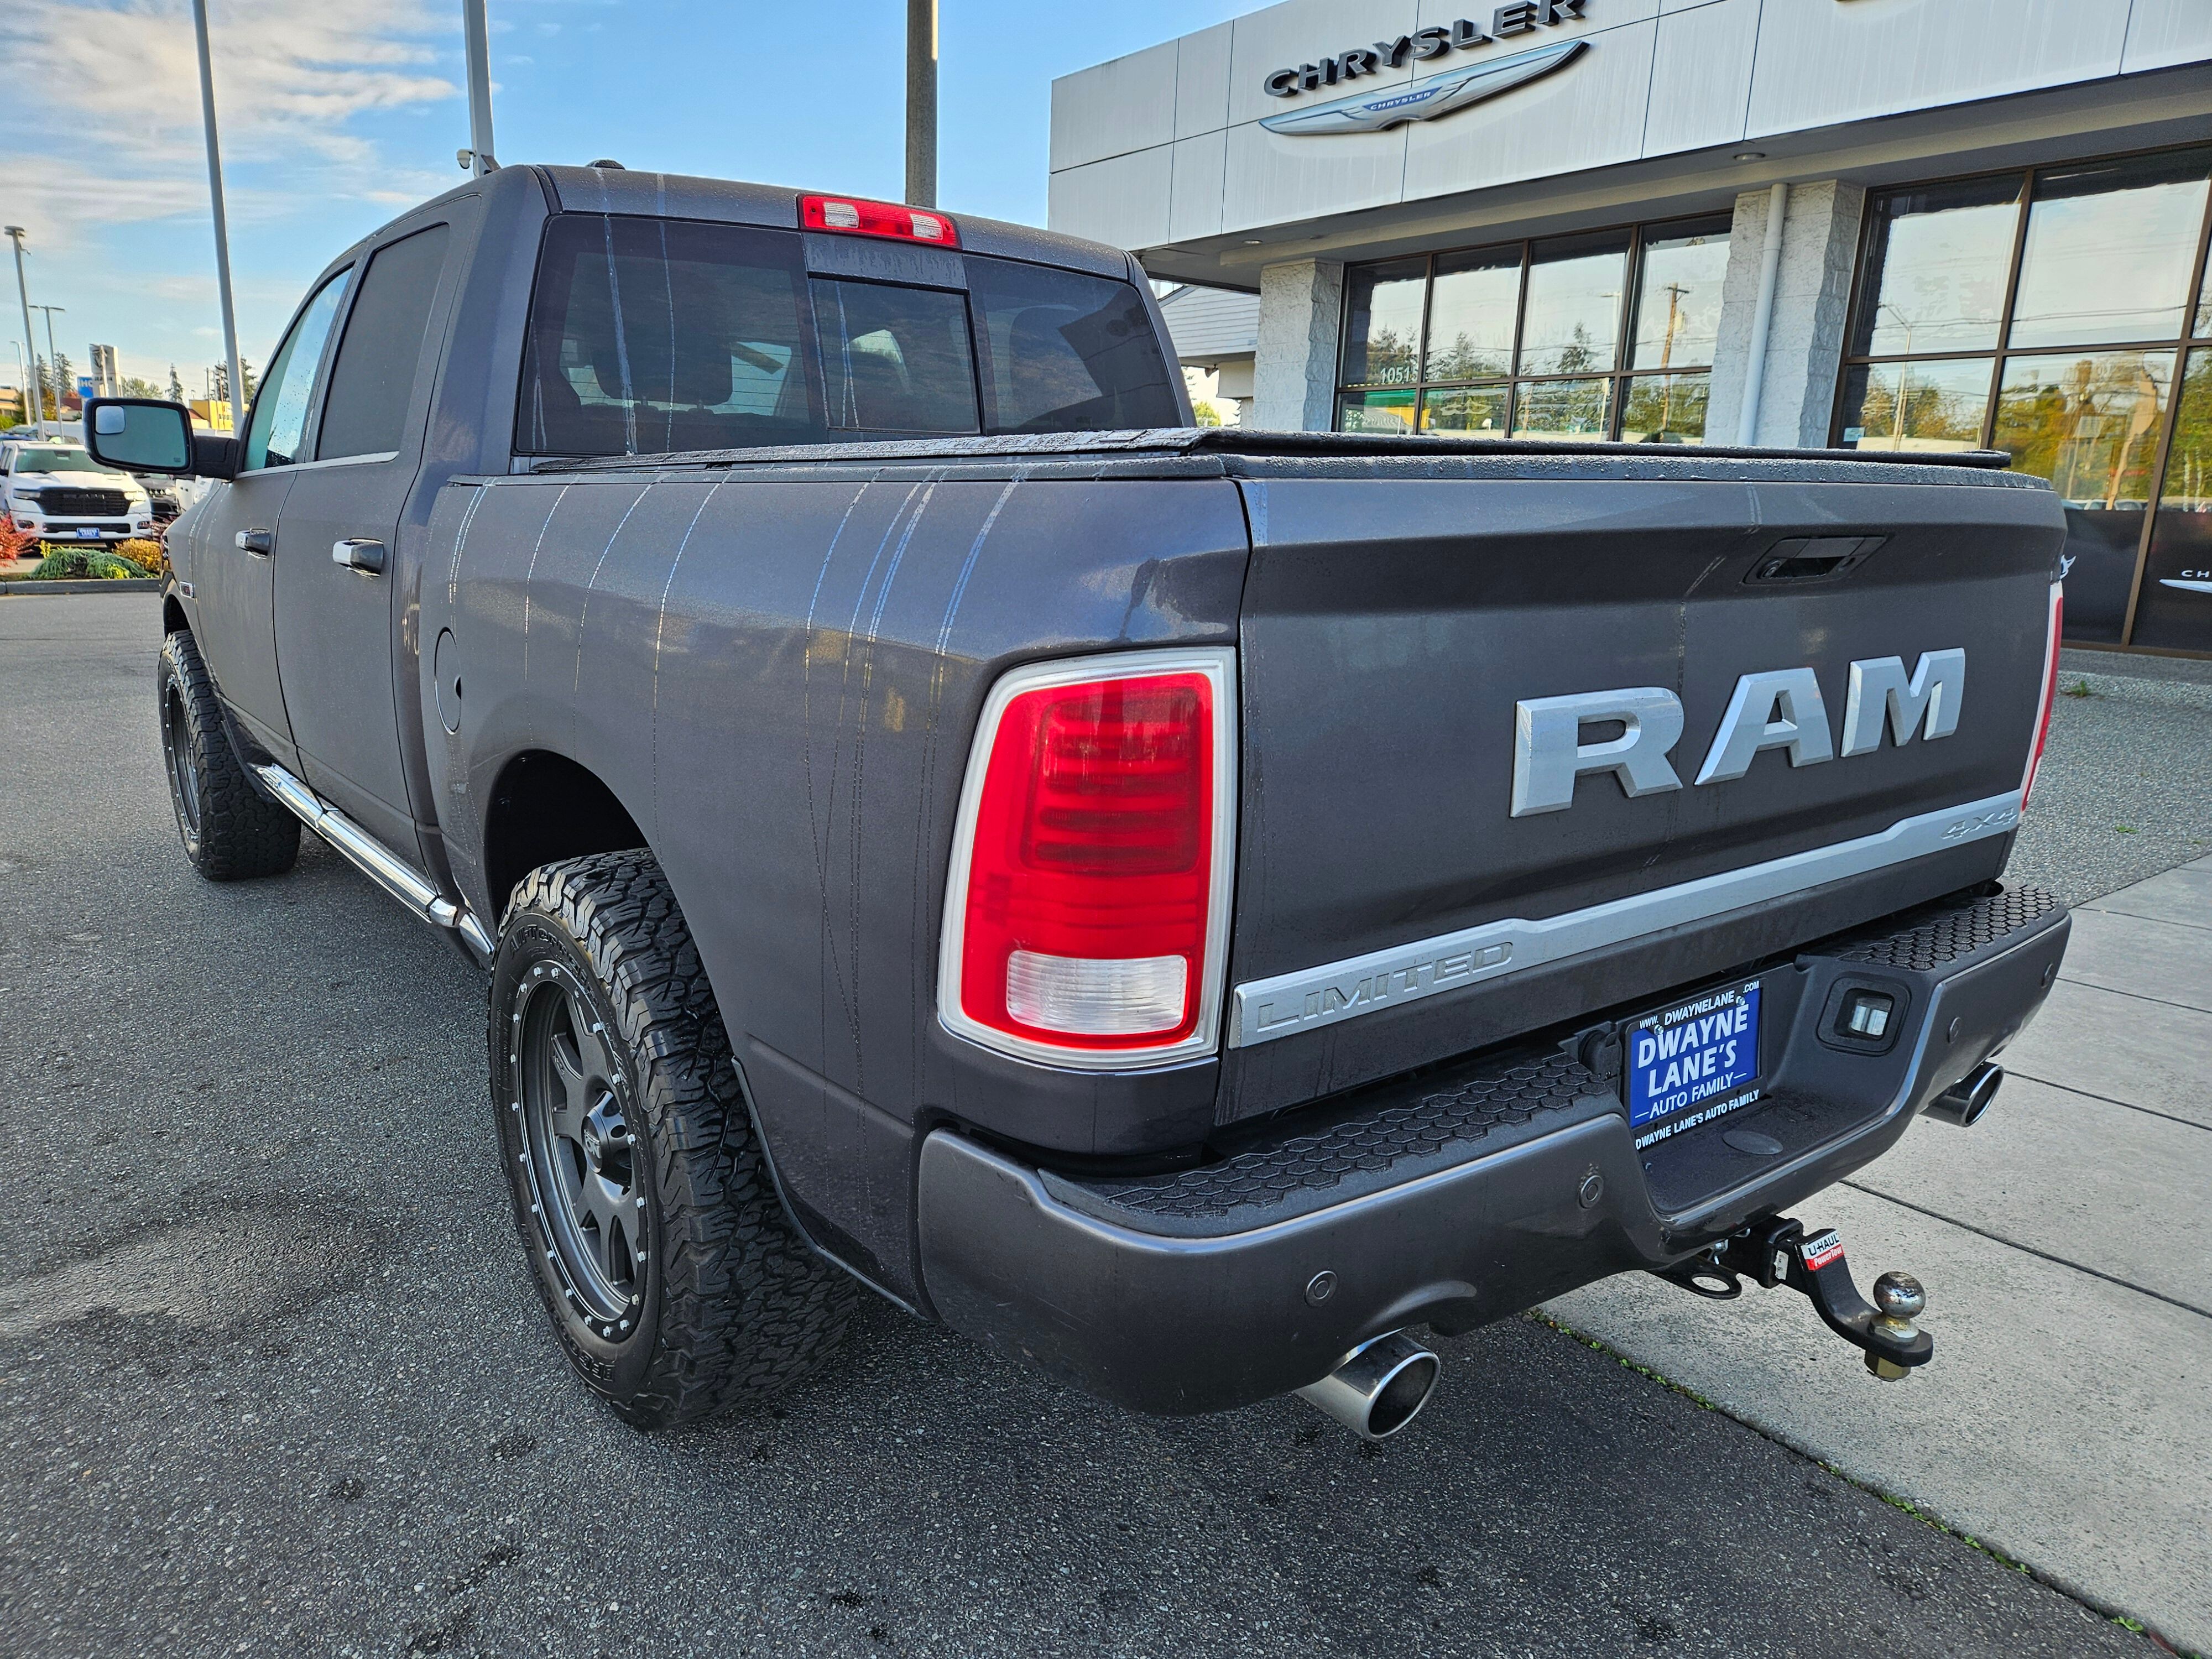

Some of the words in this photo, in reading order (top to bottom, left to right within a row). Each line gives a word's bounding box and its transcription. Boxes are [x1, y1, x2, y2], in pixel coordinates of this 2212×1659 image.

[1264, 0, 1586, 97] CHRYSLER
[1370, 91, 1431, 110] CHRYSLER
[1380, 366, 1418, 384] 10515
[2181, 570, 2210, 578] CH
[1510, 647, 1966, 818] RAM
[1257, 942, 1513, 1032] LIMITED
[1665, 990, 1735, 1026] DWAYNELANE
[1743, 980, 1760, 994] .COM
[1638, 1004, 1749, 1068] DWAYNE
[1648, 1040, 1738, 1098] LANE'S
[1635, 1125, 1671, 1150] DWAYNE
[1674, 1112, 1704, 1133] LANE'S
[1705, 1102, 1728, 1121] AUTO
[1729, 1089, 1760, 1111] FAMILY
[1650, 1092, 1688, 1119] AUTO
[1692, 1072, 1734, 1102] FAMILY
[1814, 1246, 1843, 1267] PowerTow
